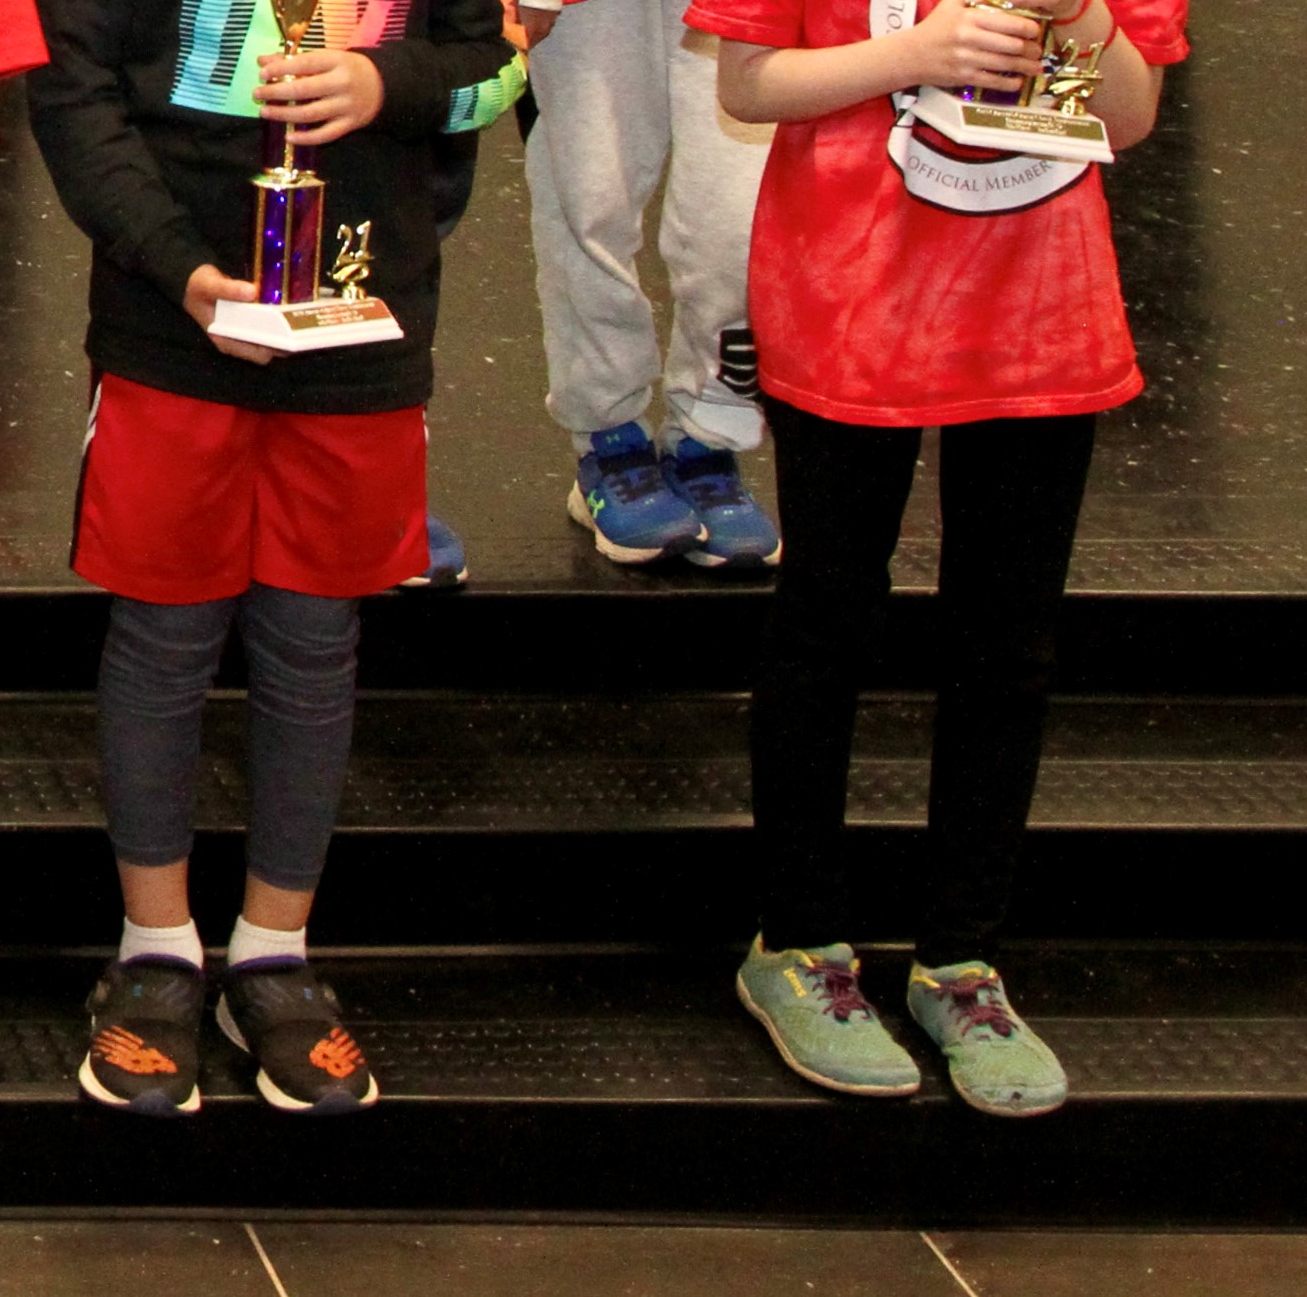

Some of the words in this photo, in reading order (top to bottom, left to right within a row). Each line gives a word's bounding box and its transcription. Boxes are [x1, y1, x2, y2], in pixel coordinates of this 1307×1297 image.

[1054, 38, 1105, 79] 21
[907, 155, 980, 192] OFFICIAL
[985, 159, 1053, 191] MEMBER
[336, 220, 373, 266] 21
